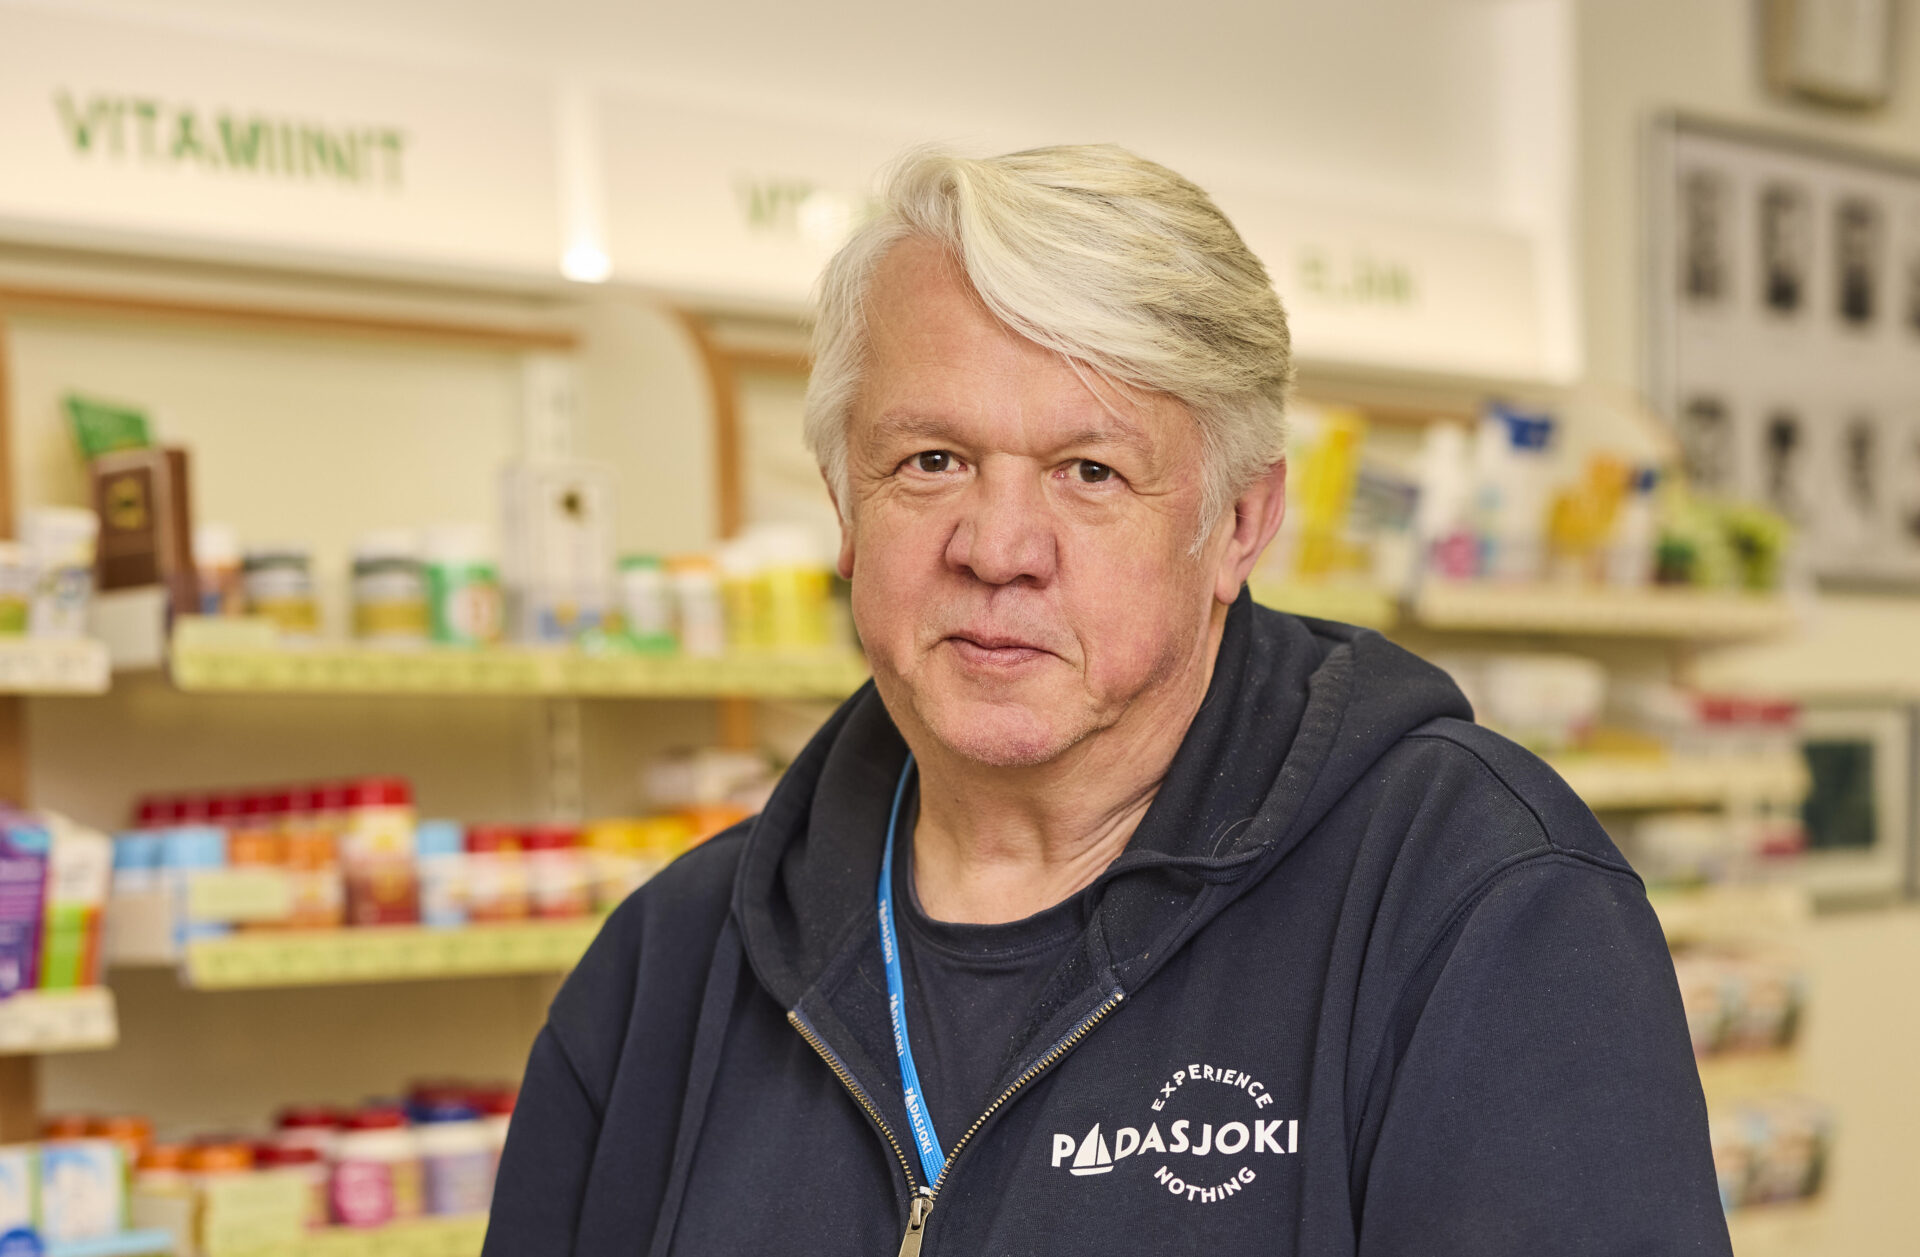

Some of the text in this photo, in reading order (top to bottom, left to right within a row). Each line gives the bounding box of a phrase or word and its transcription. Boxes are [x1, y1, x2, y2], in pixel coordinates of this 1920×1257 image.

[1151, 1063, 1274, 1112] EXPERIENCE
[904, 1087, 933, 1154] PADASJOKI
[1051, 1119, 1299, 1176] PADASJOKI
[1153, 1165, 1257, 1203] NOTHING
